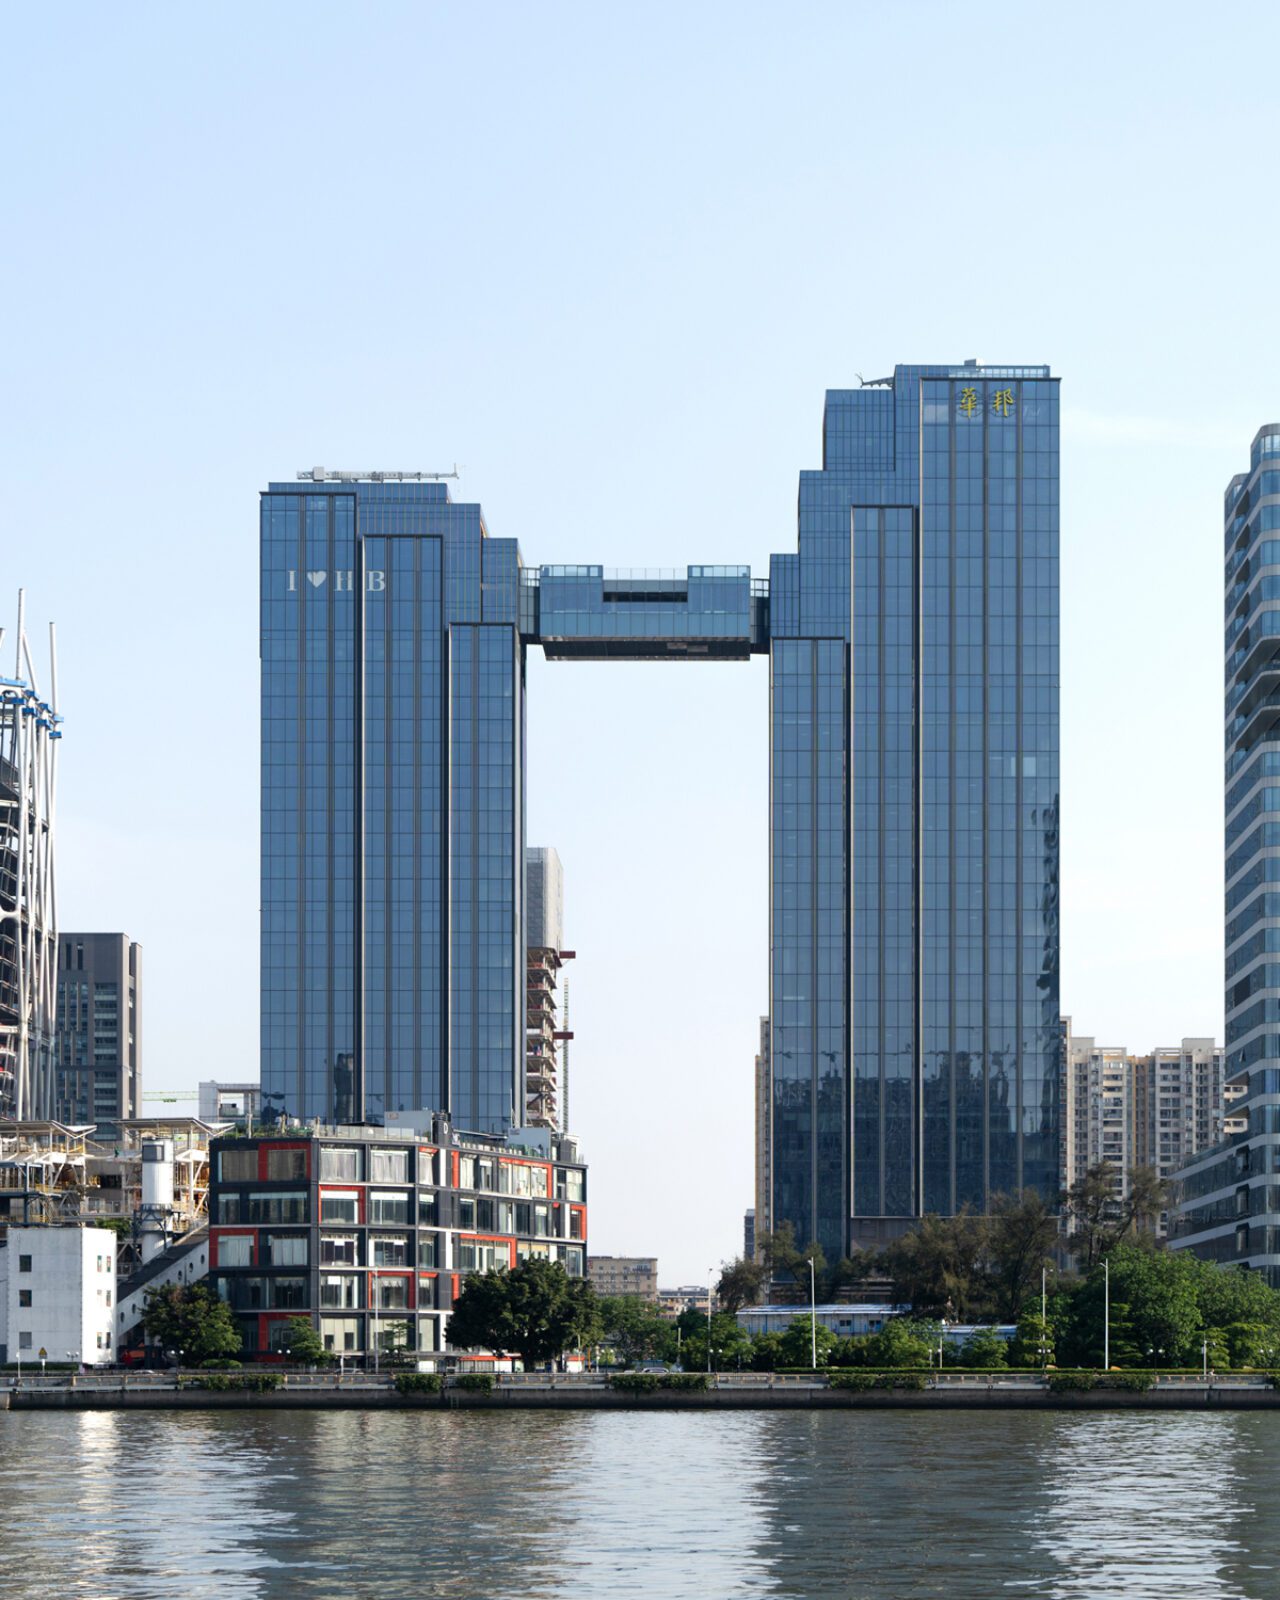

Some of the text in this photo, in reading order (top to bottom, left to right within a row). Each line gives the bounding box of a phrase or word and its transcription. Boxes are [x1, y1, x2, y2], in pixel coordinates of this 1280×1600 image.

[960, 387, 1014, 418] 華邦
[287, 570, 297, 591] I
[443, 1122, 449, 1135] D
